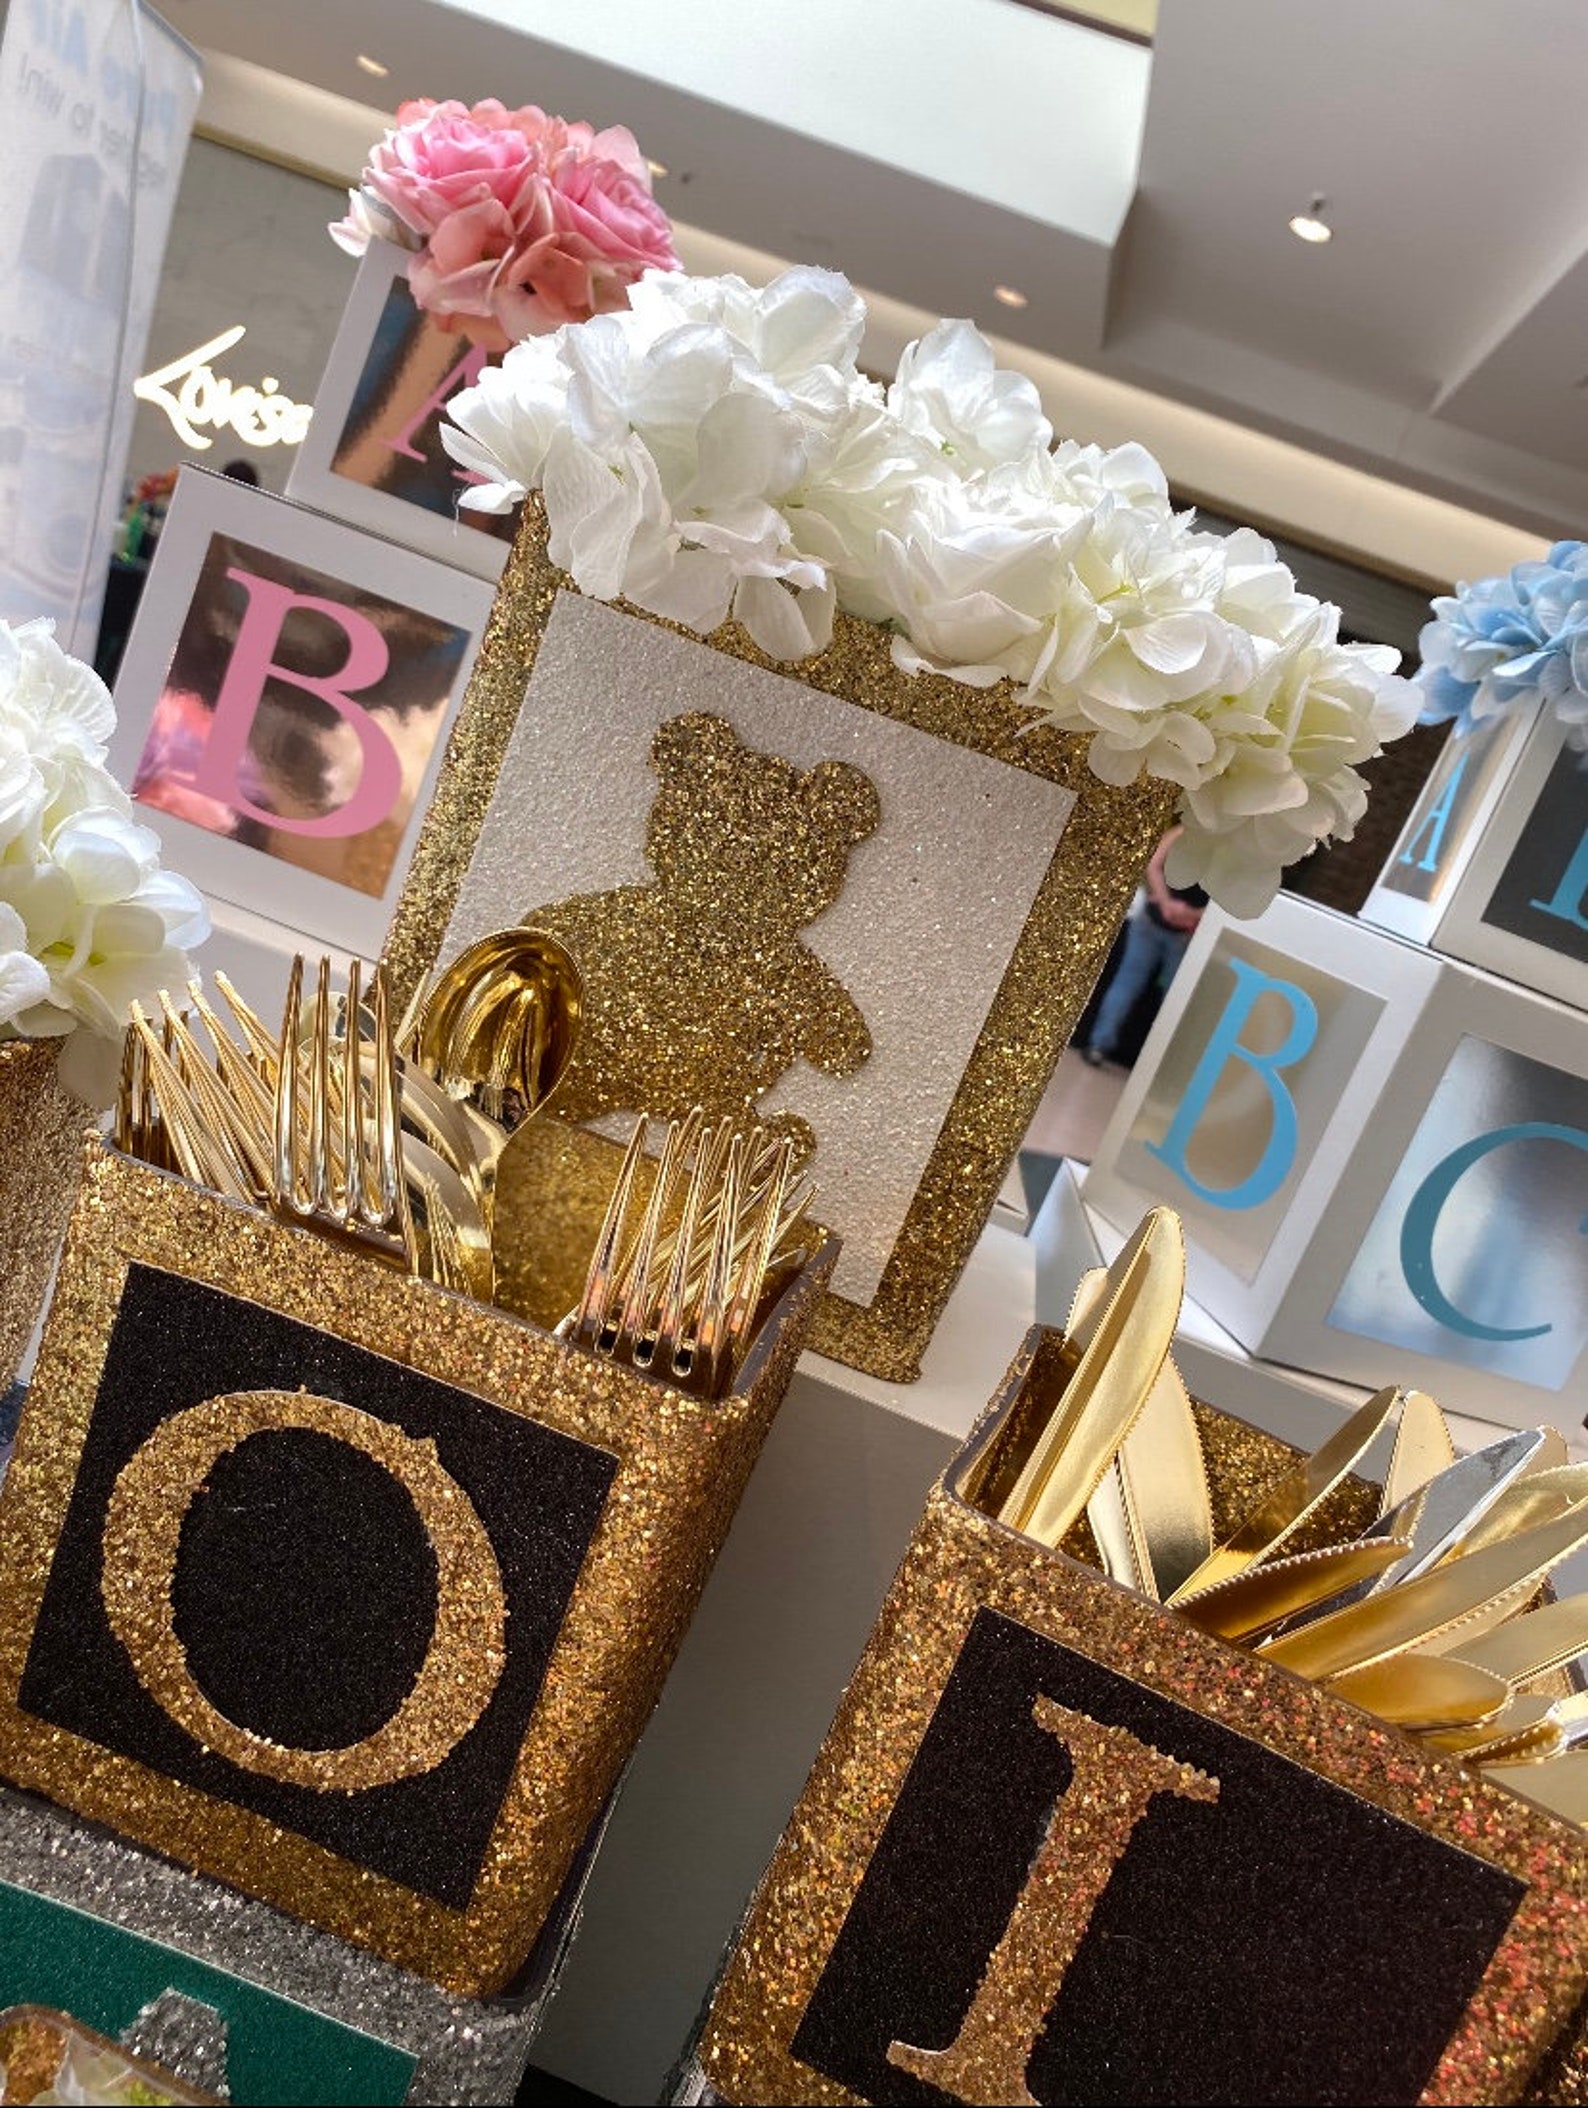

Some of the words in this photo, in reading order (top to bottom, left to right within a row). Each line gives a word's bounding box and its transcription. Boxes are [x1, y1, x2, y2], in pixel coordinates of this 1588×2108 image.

[172, 567, 403, 839] B
[1400, 748, 1472, 872] A
[1145, 957, 1318, 1211] B
[1400, 1122, 1588, 1341] C
[102, 1386, 508, 1797] O
